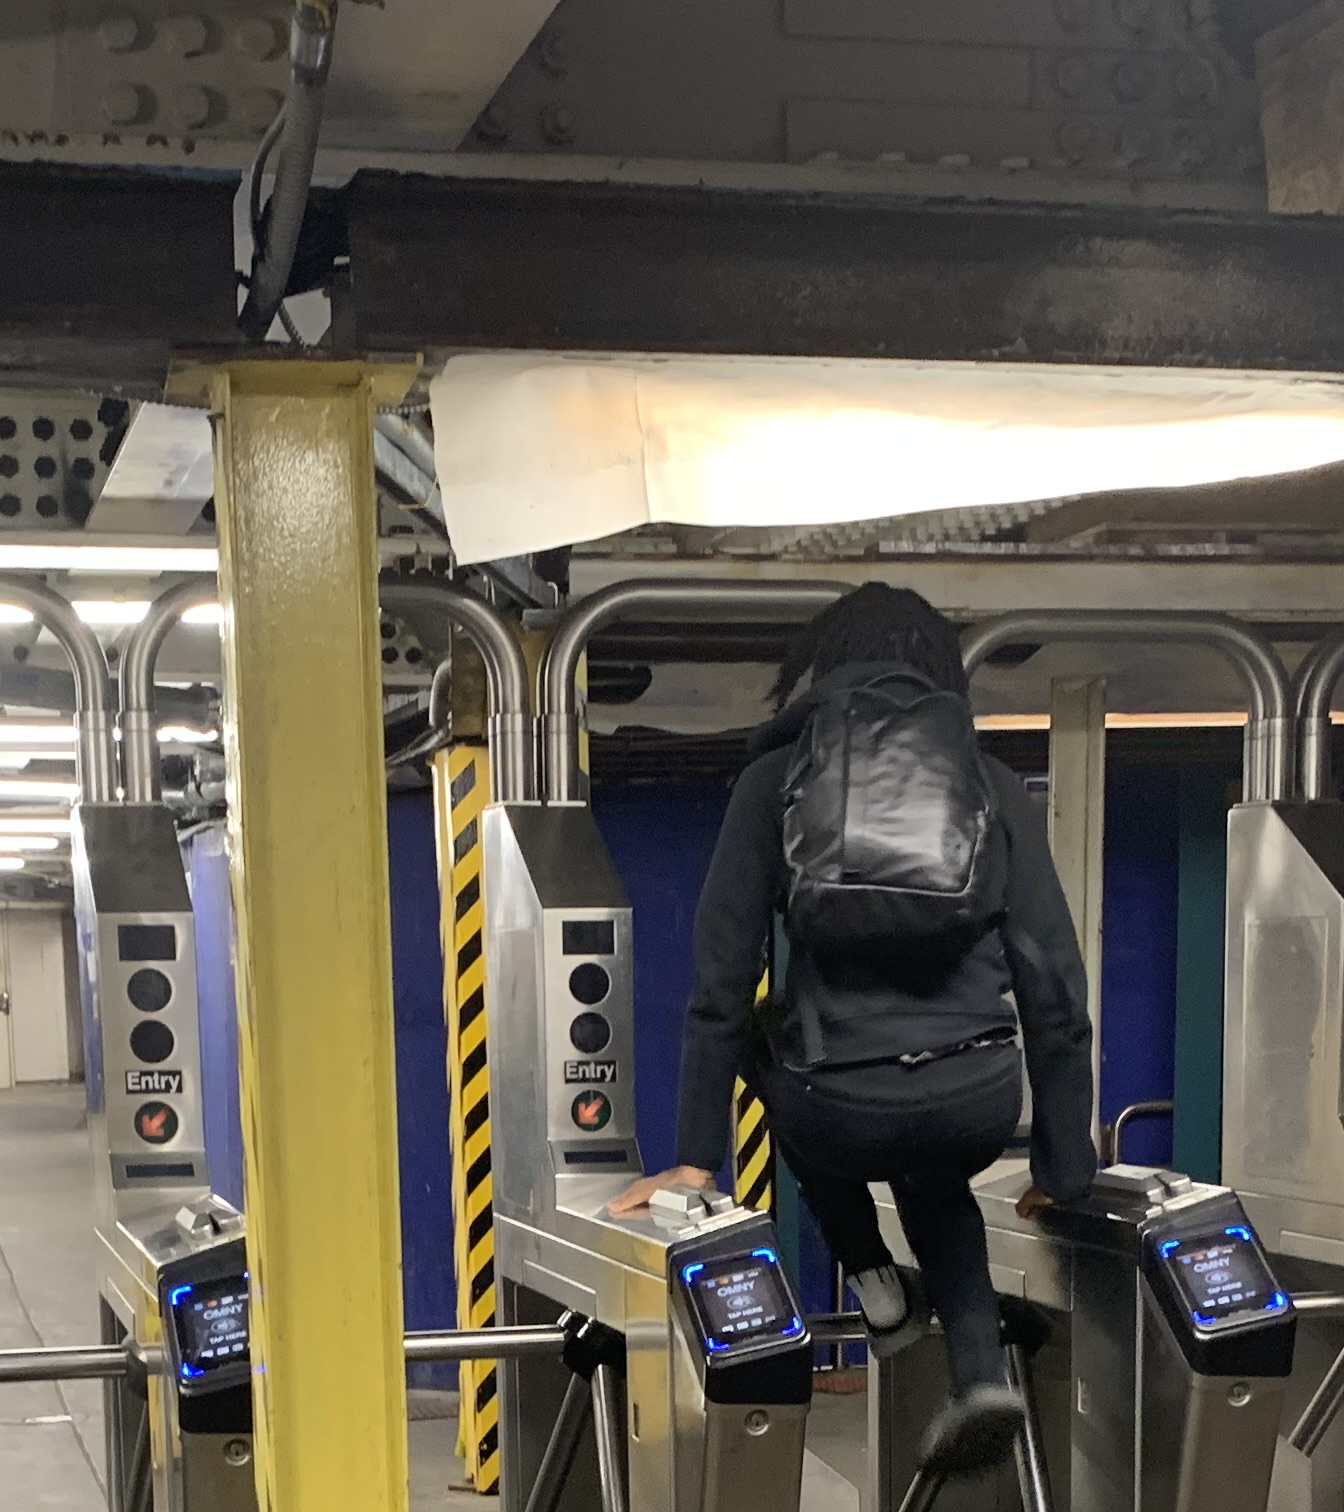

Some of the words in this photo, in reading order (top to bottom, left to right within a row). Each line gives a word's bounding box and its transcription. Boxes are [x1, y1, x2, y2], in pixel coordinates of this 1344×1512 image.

[566, 1061, 614, 1082] Entry
[127, 1071, 180, 1093] Entry
[717, 1280, 754, 1297] OMNY
[203, 1303, 243, 1320] OMNY
